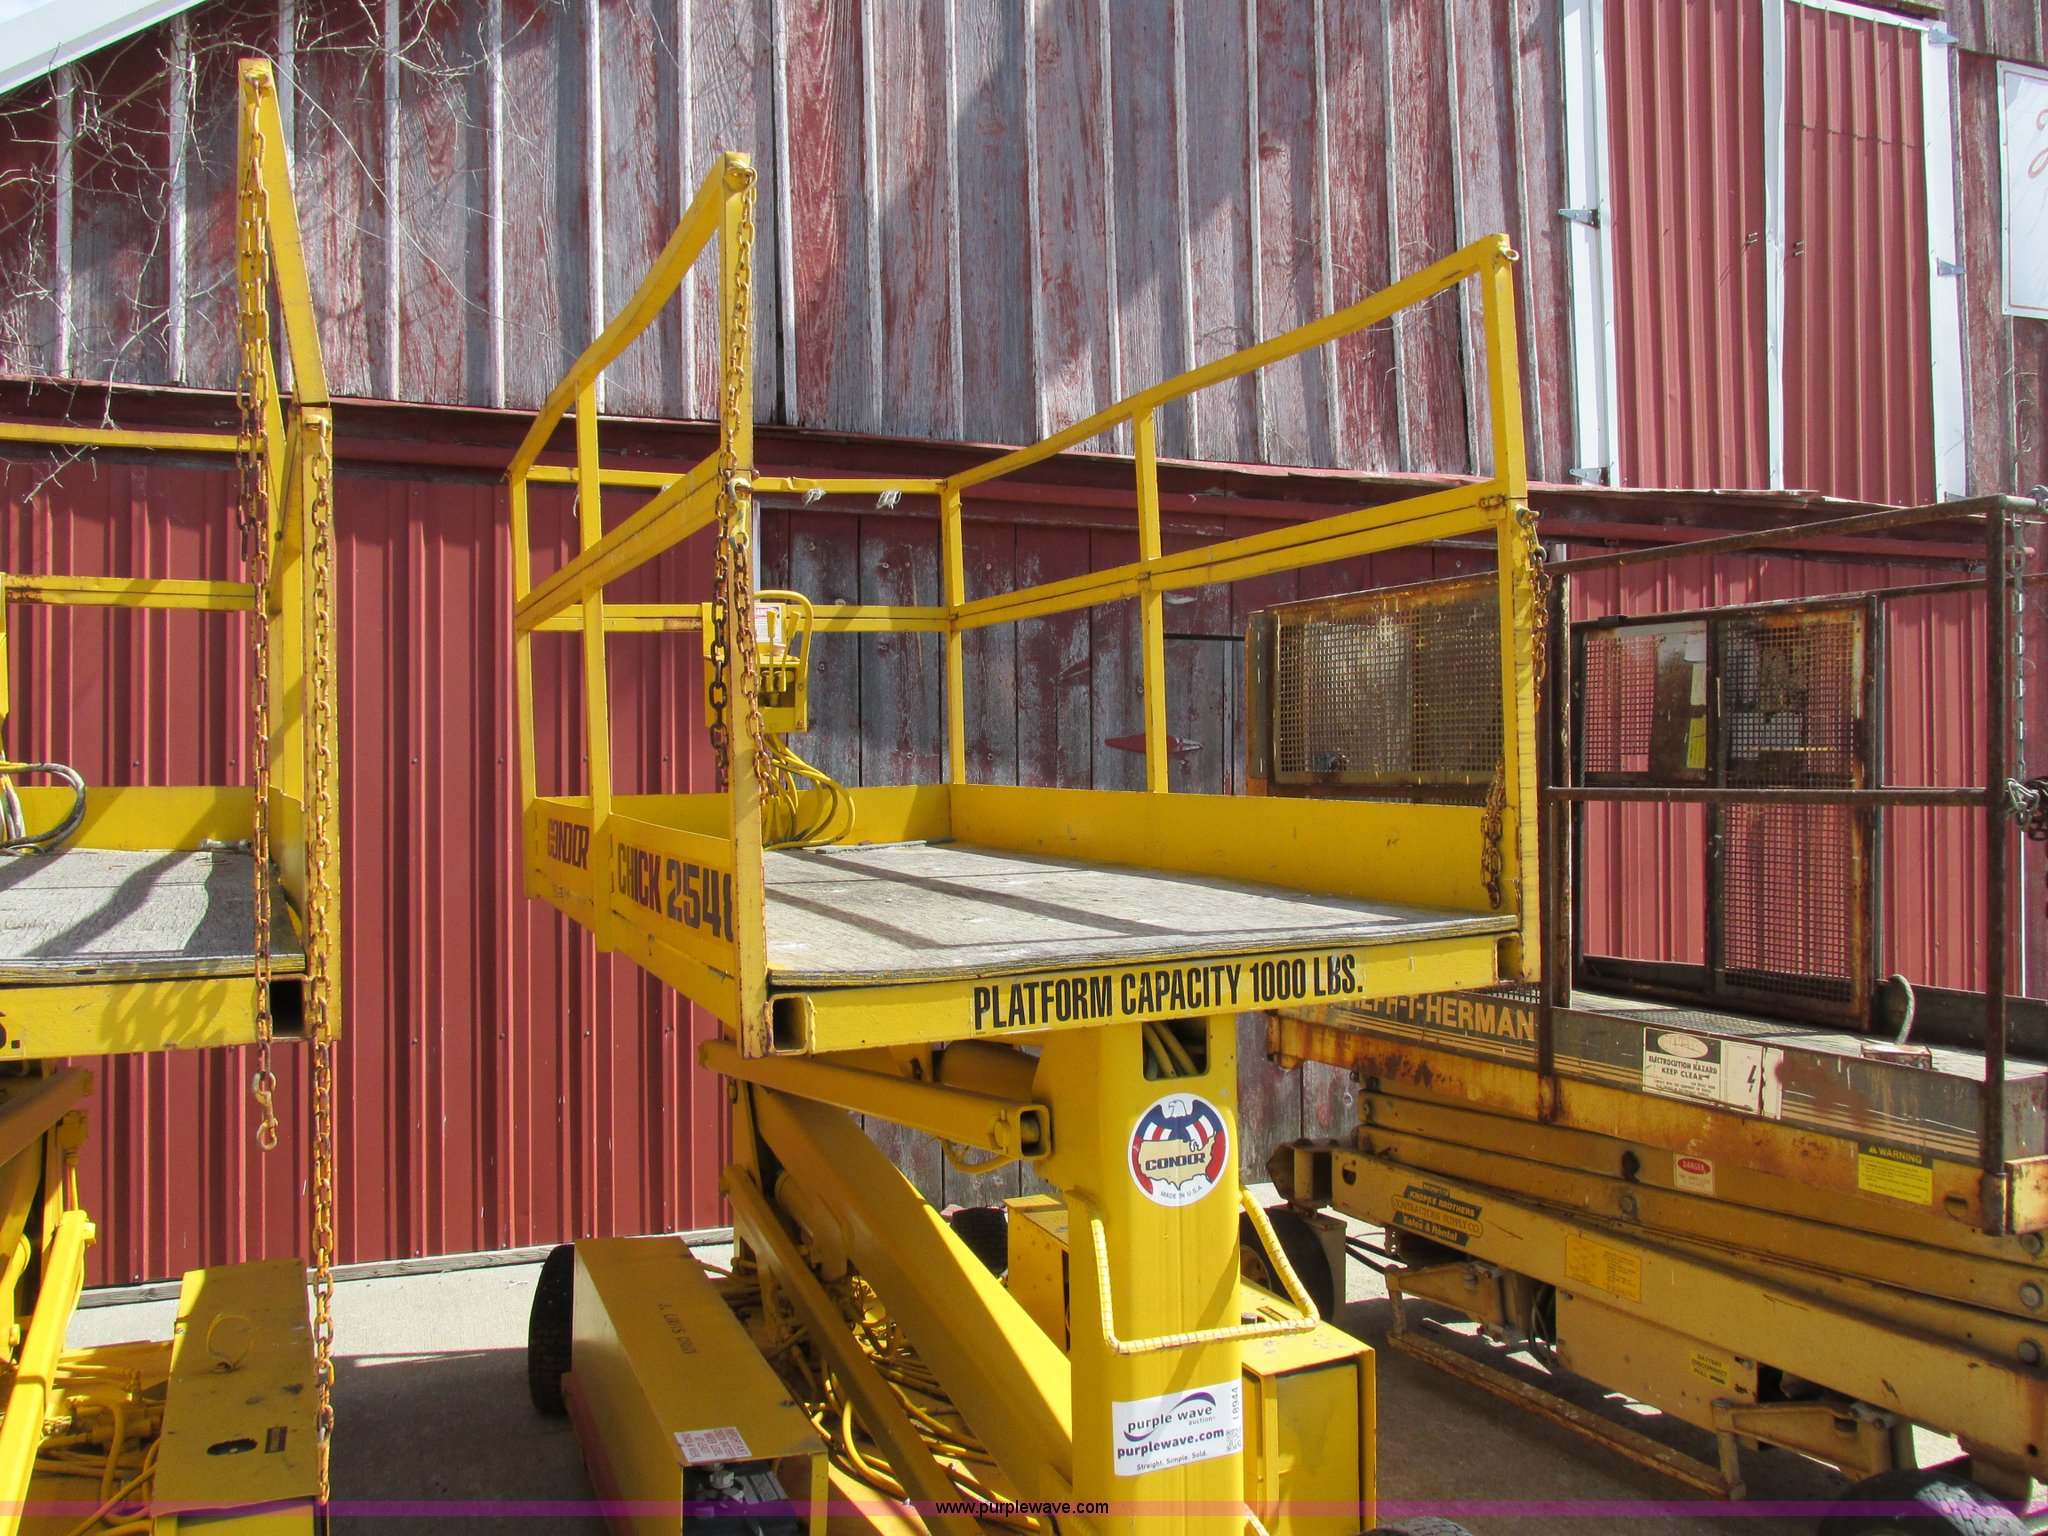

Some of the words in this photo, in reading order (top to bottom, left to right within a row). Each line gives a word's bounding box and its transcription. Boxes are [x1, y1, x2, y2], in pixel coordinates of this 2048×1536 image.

[618, 842, 662, 914] CHICK
[974, 975, 1113, 1030] PLATFORM
[1121, 964, 1242, 1015] CAPACITY
[1250, 959, 1306, 1003] 1000
[1314, 954, 1363, 997] LBS.
[1648, 1055, 1692, 1070] ELECTROCUTION
[1693, 1062, 1718, 1075] HAZARD
[1662, 1067, 1678, 1076] KEEP
[1681, 1071, 1704, 1081] CLEAR
[1145, 1152, 1206, 1171] CONDOR
[1879, 1147, 1922, 1164] WARNING
[1161, 1191, 1176, 1200] MADE
[1128, 1414, 1173, 1433] purple
[1177, 1406, 1213, 1421] wave
[1188, 1416, 1213, 1426] auction
[1117, 1428, 1224, 1459] purplewave.com
[1191, 1449, 1208, 1459] Sold.
